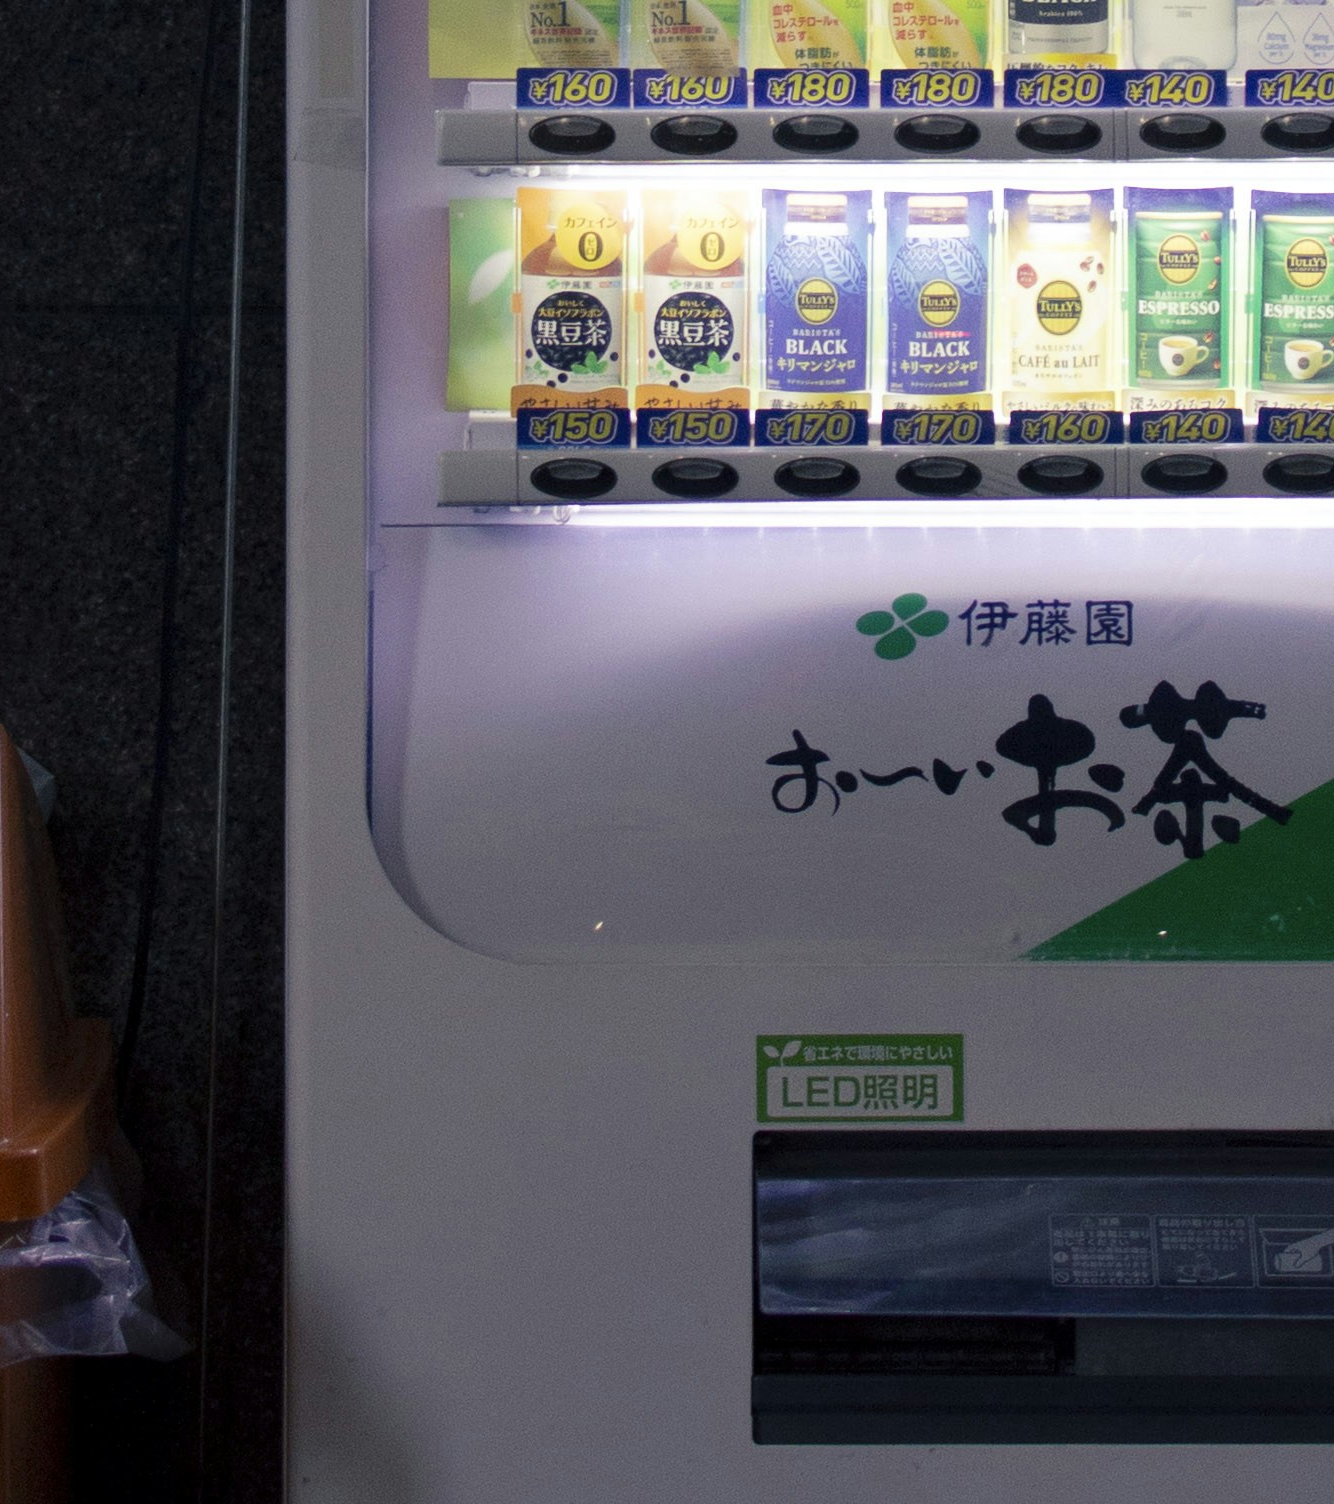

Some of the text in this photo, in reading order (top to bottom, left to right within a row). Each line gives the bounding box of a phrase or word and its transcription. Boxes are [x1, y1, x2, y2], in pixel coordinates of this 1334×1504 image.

[530, 1, 570, 28] No.1
[651, 0, 690, 28] No.1
[772, 4, 793, 15] 血中
[892, 2, 914, 13] 血中
[532, 72, 612, 101] ¥160
[769, 73, 850, 101] ¥180
[893, 73, 975, 101] ¥180
[1019, 73, 1100, 102] ¥180
[1127, 74, 1210, 104] ¥140
[564, 217, 617, 229] カフェイン
[686, 217, 740, 229] カフェイン
[539, 307, 604, 318] 大豆イソフラボン
[661, 307, 726, 318] 大豆イソフラボン
[1138, 299, 1220, 315] ESPRESSO
[536, 319, 607, 346] 黒豆茶
[658, 319, 729, 346] 黒豆茶
[785, 338, 848, 356] BLACK
[909, 341, 971, 358] BLACK
[777, 357, 856, 372] キリマンジャロ
[900, 358, 978, 374] キリマンジャロ
[1018, 353, 1100, 369] CAFÉ au LAIT
[531, 412, 613, 440] ¥150
[651, 412, 732, 440] ¥150
[768, 414, 850, 442] ¥170
[895, 415, 977, 441] ¥170
[1025, 413, 1105, 442] ¥160
[1145, 413, 1226, 442] ¥140
[957, 598, 1134, 649] 伊藤園
[802, 1043, 954, 1062] 省エネで環境にやさしい
[780, 1072, 939, 1111] LED照明
